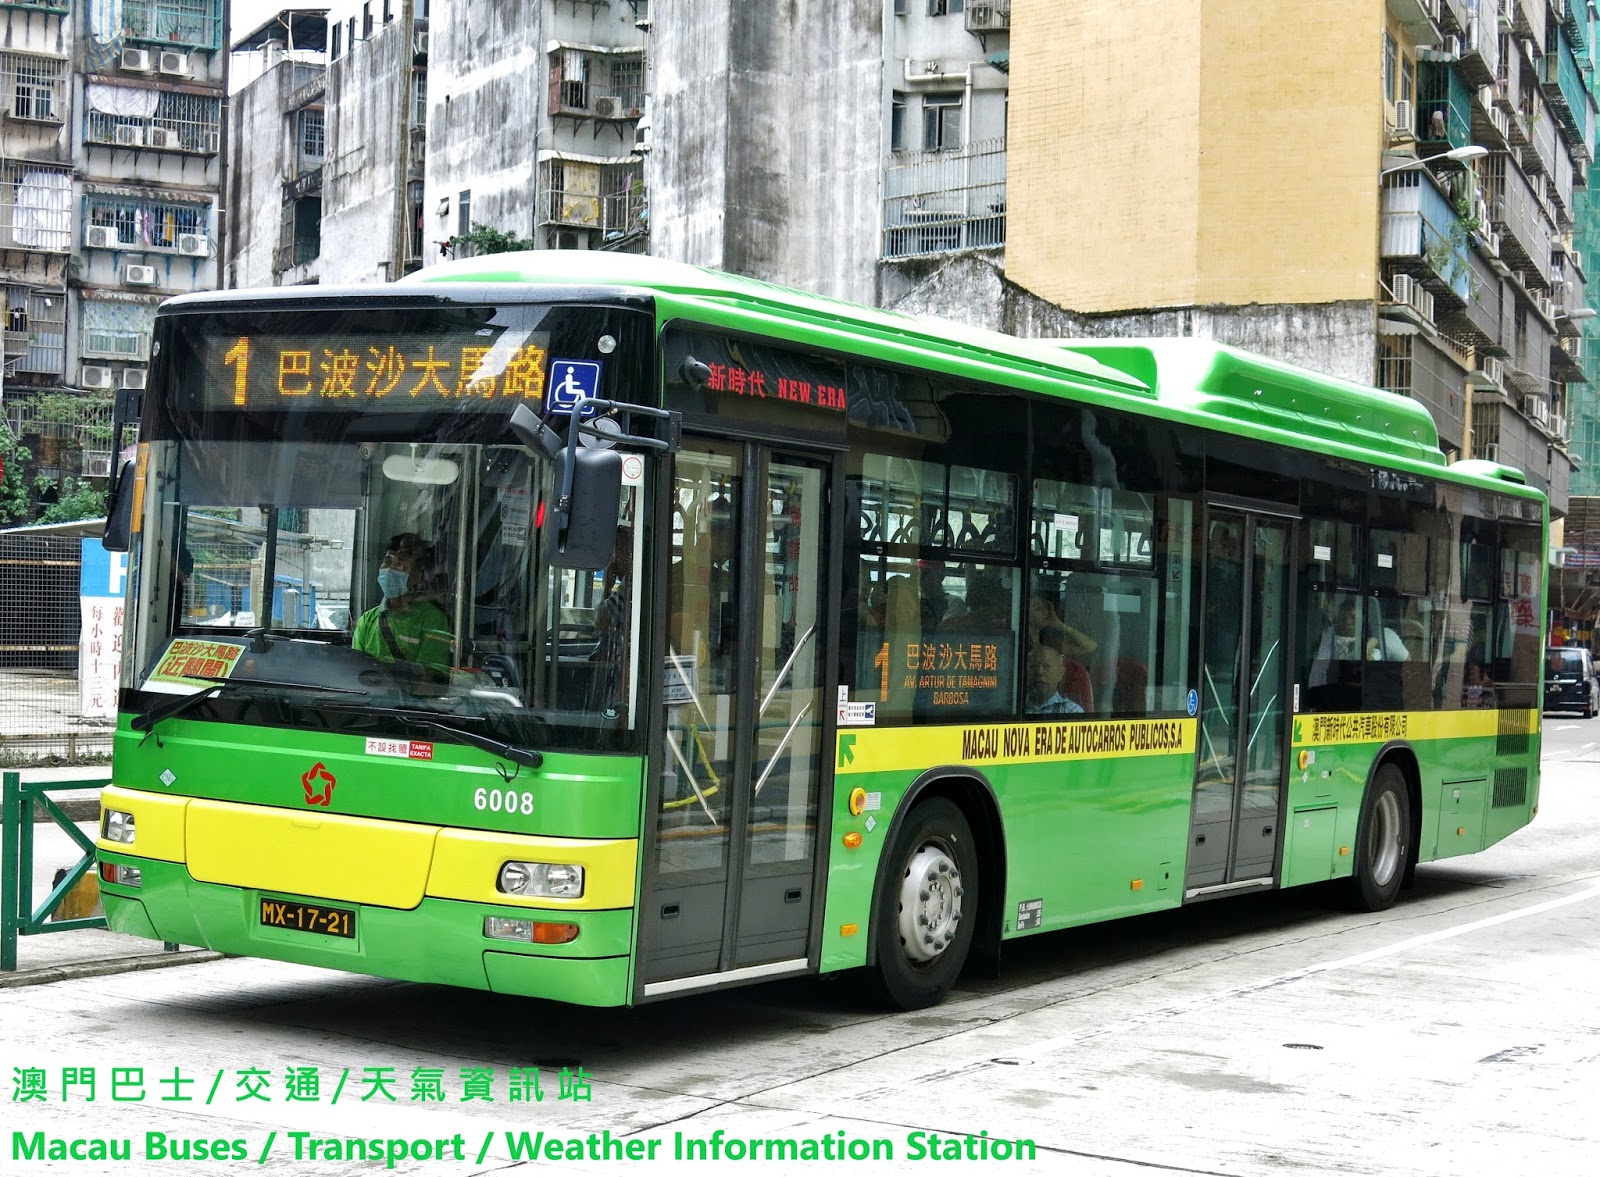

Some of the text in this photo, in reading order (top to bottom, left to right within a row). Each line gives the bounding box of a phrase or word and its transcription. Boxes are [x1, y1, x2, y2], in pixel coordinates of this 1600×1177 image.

[225, 336, 546, 405] 1 巴波沙大馬路
[708, 361, 847, 410] 新時代 NEW ERA
[169, 641, 241, 661] 巴波沙大馬路
[874, 642, 998, 702] 1 巴波沙大馬路
[904, 675, 998, 689] AV. ARTUR DE TAMAGNINI
[933, 691, 970, 705] BARBOSA
[962, 728, 998, 760] MACAU
[1003, 727, 1030, 758] NOVA
[1035, 726, 1053, 756] ERA
[1055, 726, 1067, 755] DE
[1068, 724, 1126, 754] AUTOCARROS
[1312, 715, 1408, 742] 澳門新時代公共汽車股份有限公司
[368, 741, 408, 755] 不設找贖
[409, 750, 432, 758] EXACTA
[411, 743, 431, 751] TARIFA
[474, 787, 534, 816] 6008
[262, 902, 348, 935] MX-17-21
